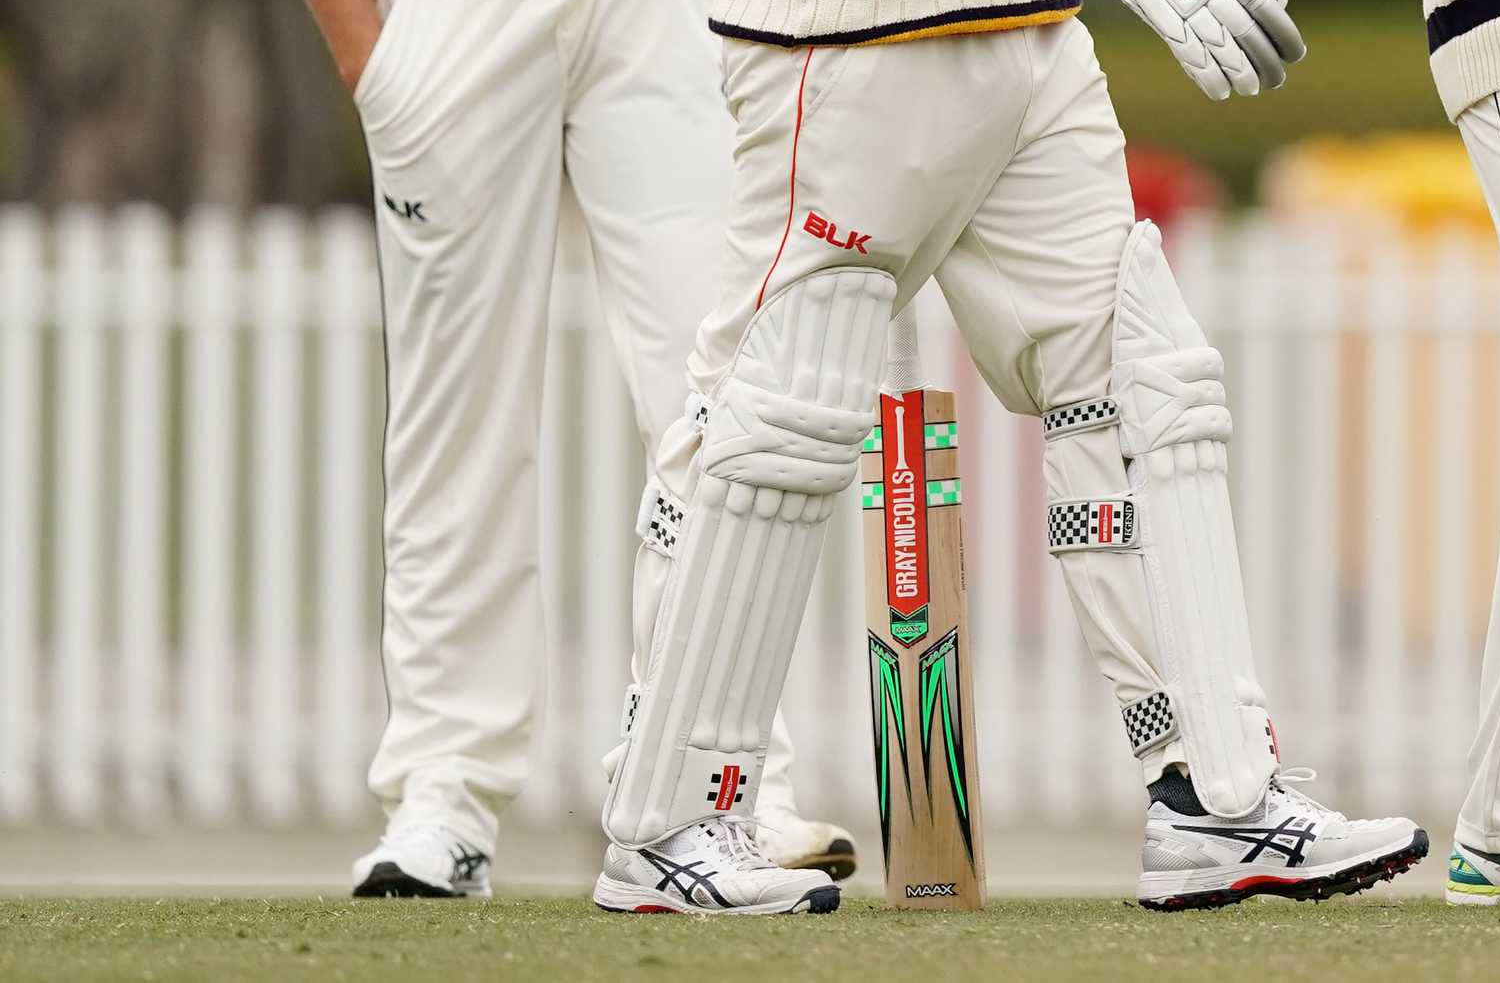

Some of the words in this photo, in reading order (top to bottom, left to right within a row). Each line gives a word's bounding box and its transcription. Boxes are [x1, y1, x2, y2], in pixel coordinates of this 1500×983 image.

[803, 210, 872, 255] BLK
[892, 470, 918, 598] GRAY-NICOLLS
[905, 882, 957, 898] MAAX
